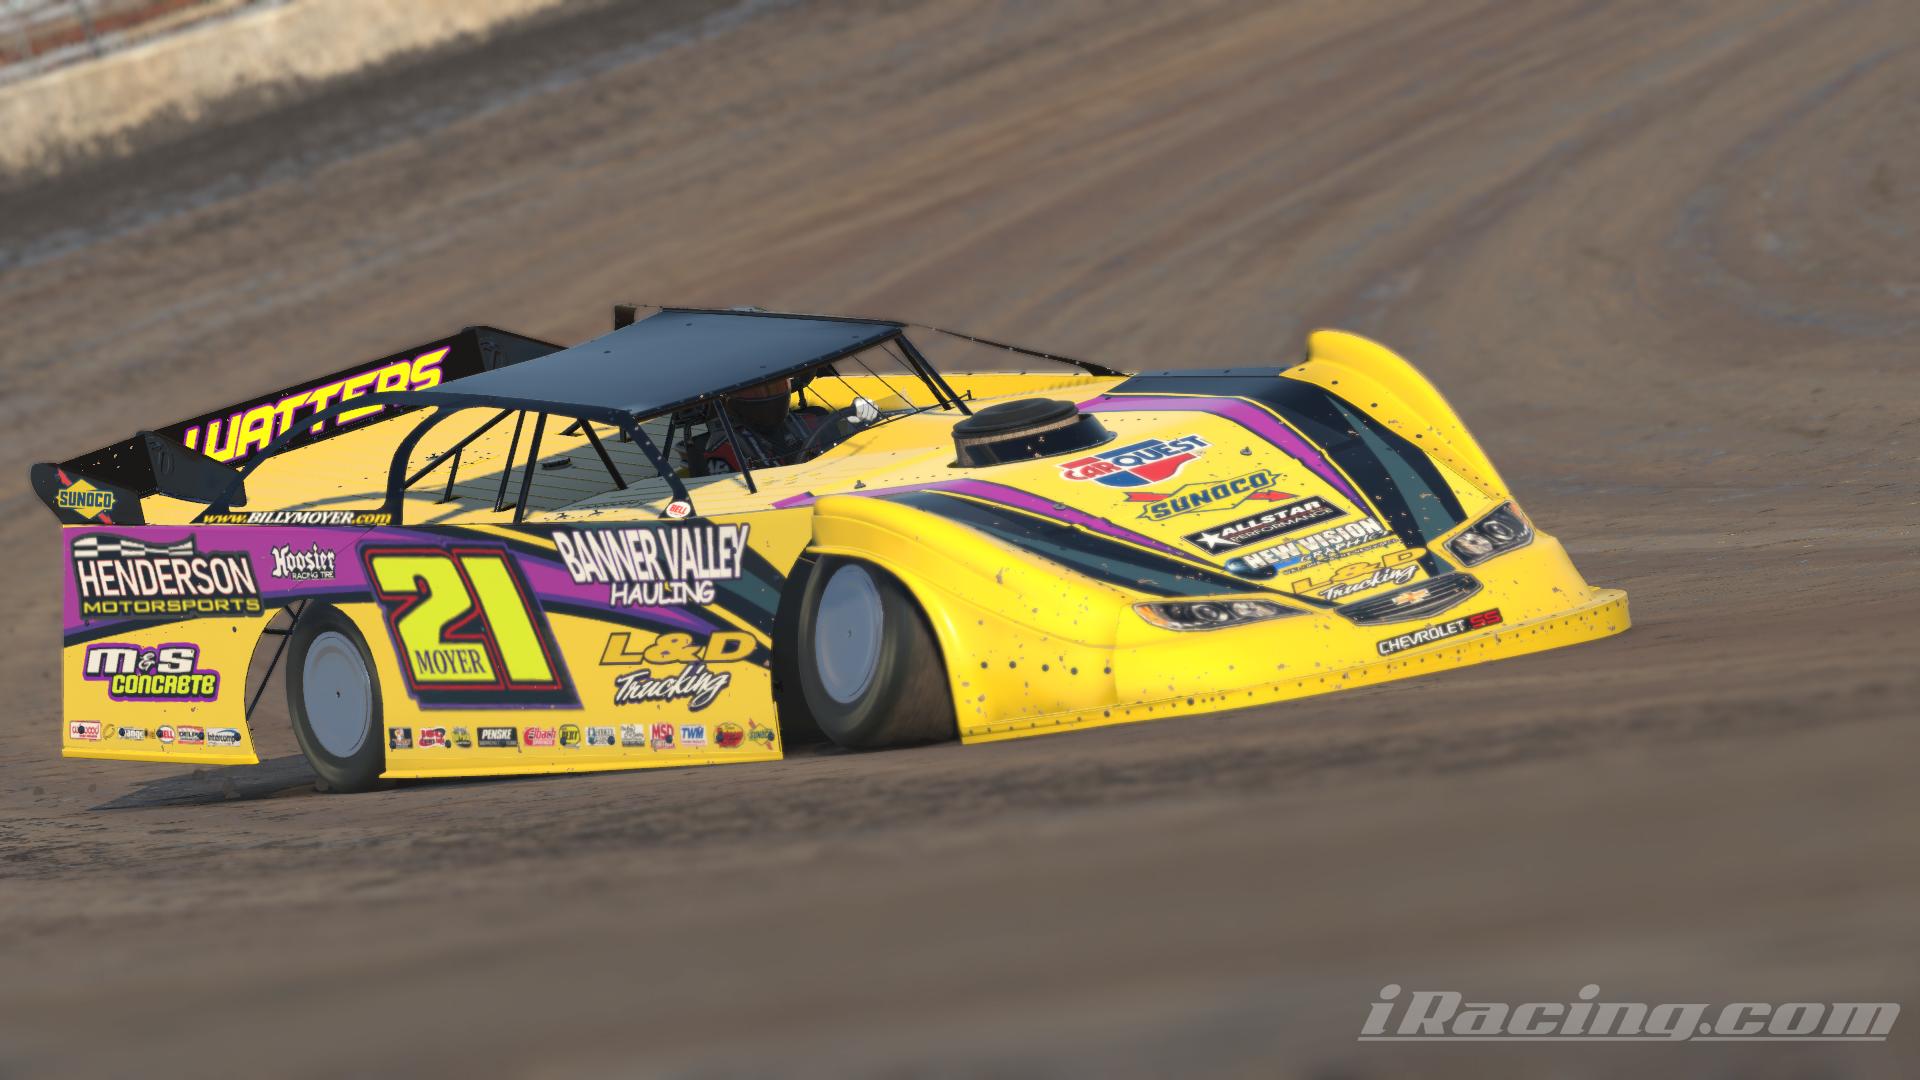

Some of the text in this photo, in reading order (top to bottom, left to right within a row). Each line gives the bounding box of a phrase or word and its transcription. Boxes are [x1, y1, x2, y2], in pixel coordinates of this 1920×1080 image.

[58, 490, 114, 509] SUNOCO
[1150, 471, 1269, 519] SUNOCO
[203, 511, 392, 526] www.BILLYMOYER.com
[1222, 501, 1321, 537] ALLSTAR
[272, 543, 335, 577] Hoosier
[552, 524, 750, 584] BANNER VALLEY
[1244, 541, 1300, 569] NEW
[1297, 517, 1383, 551] VISION
[77, 557, 257, 597] HENDERSON
[1292, 548, 1426, 594] L&D
[1318, 564, 1418, 601] Trucking
[83, 599, 260, 614] MOTORSPORTS
[610, 580, 715, 607] HAULING
[370, 553, 556, 684] 21
[1377, 609, 1501, 655] CHEVROLET SS
[415, 649, 487, 676] MOYER
[600, 631, 757, 665] L&D
[615, 664, 731, 711] Trucking
[482, 729, 512, 739] PENSKE
[652, 724, 674, 739] MSD
[682, 727, 704, 739] TWM
